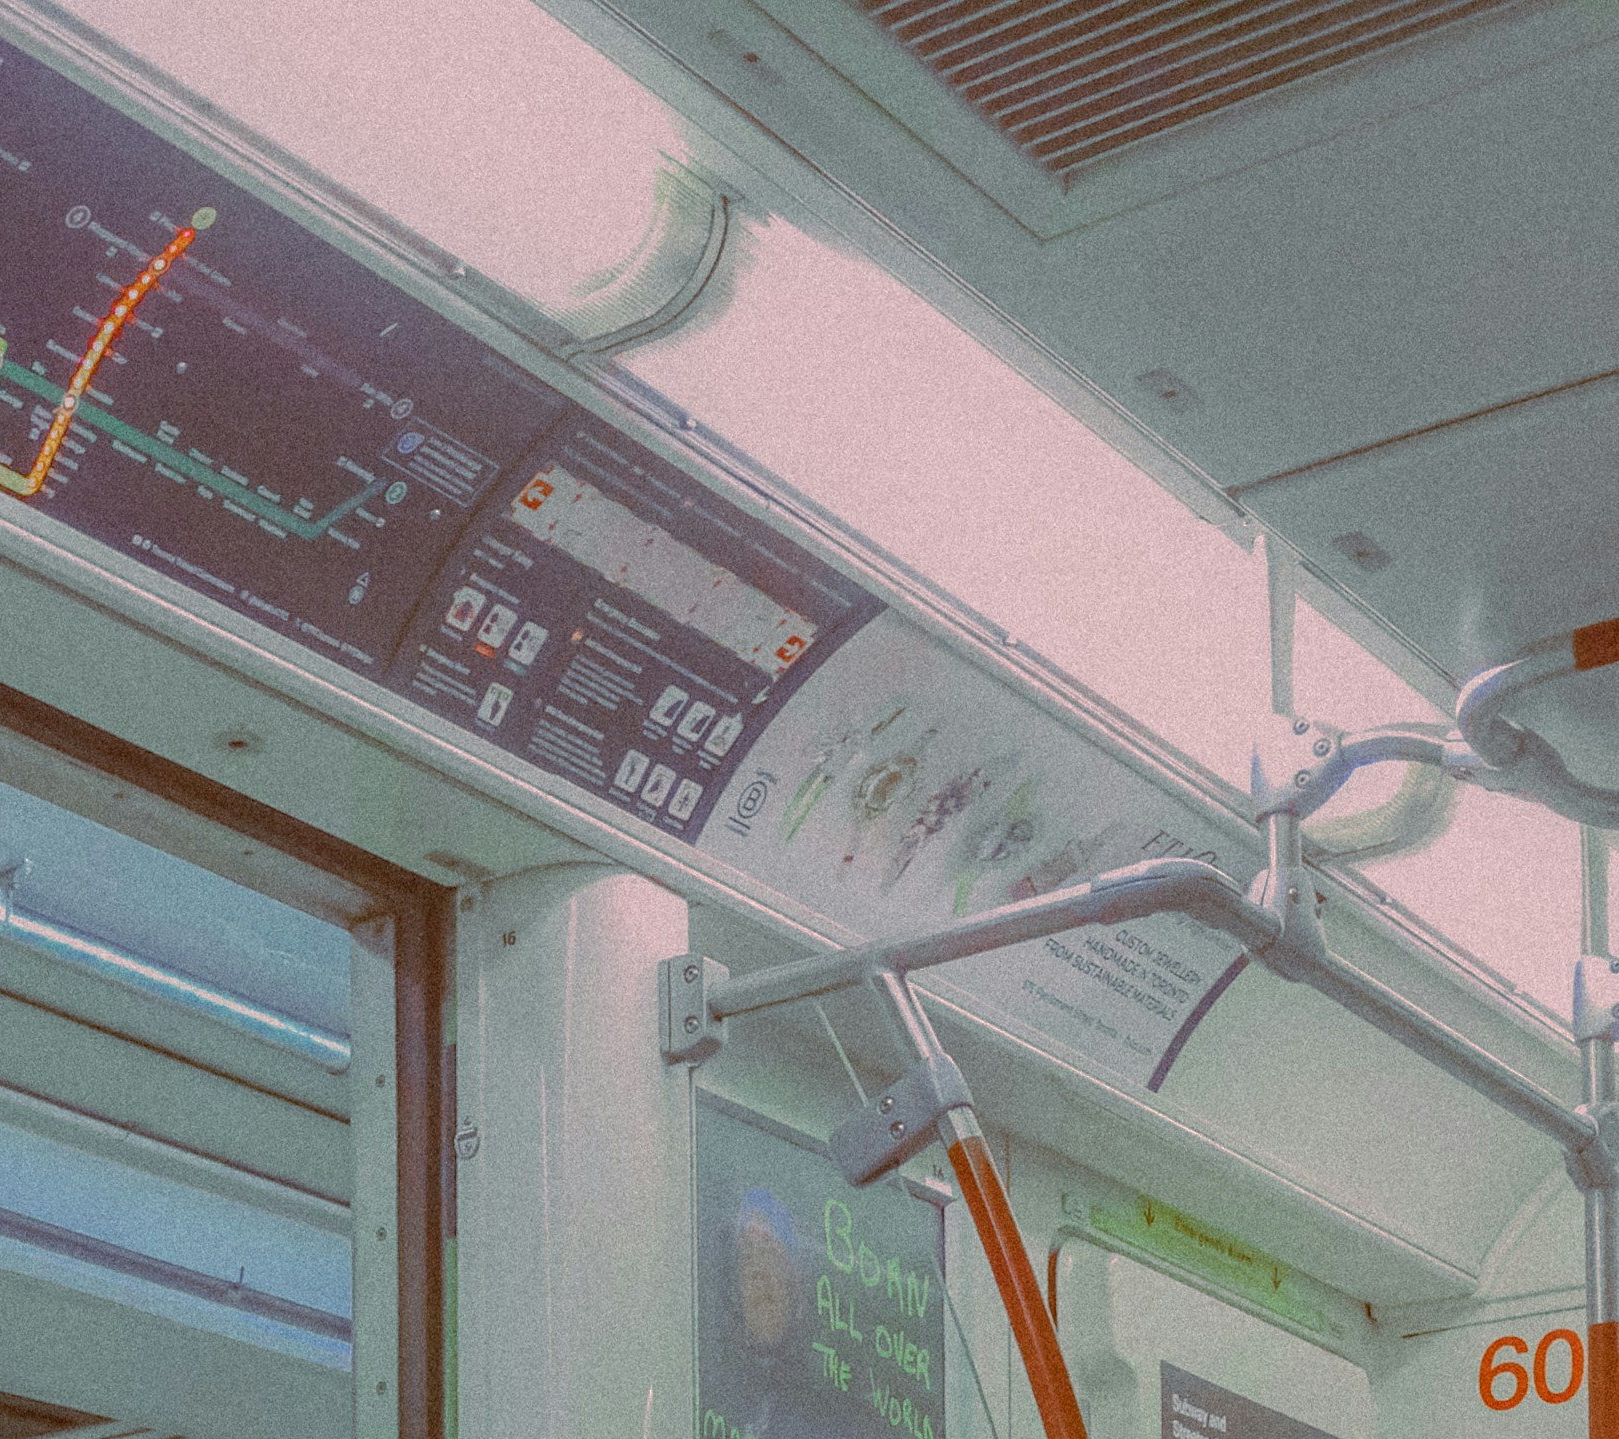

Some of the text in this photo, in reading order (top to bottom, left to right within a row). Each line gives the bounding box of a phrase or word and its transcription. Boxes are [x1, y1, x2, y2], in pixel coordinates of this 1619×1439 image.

[1043, 938, 1073, 963] FROM
[824, 1199, 930, 1318] BORN
[812, 1341, 853, 1392] THE
[816, 1274, 931, 1391] ALL OVER
[1478, 1328, 1584, 1412] 60
